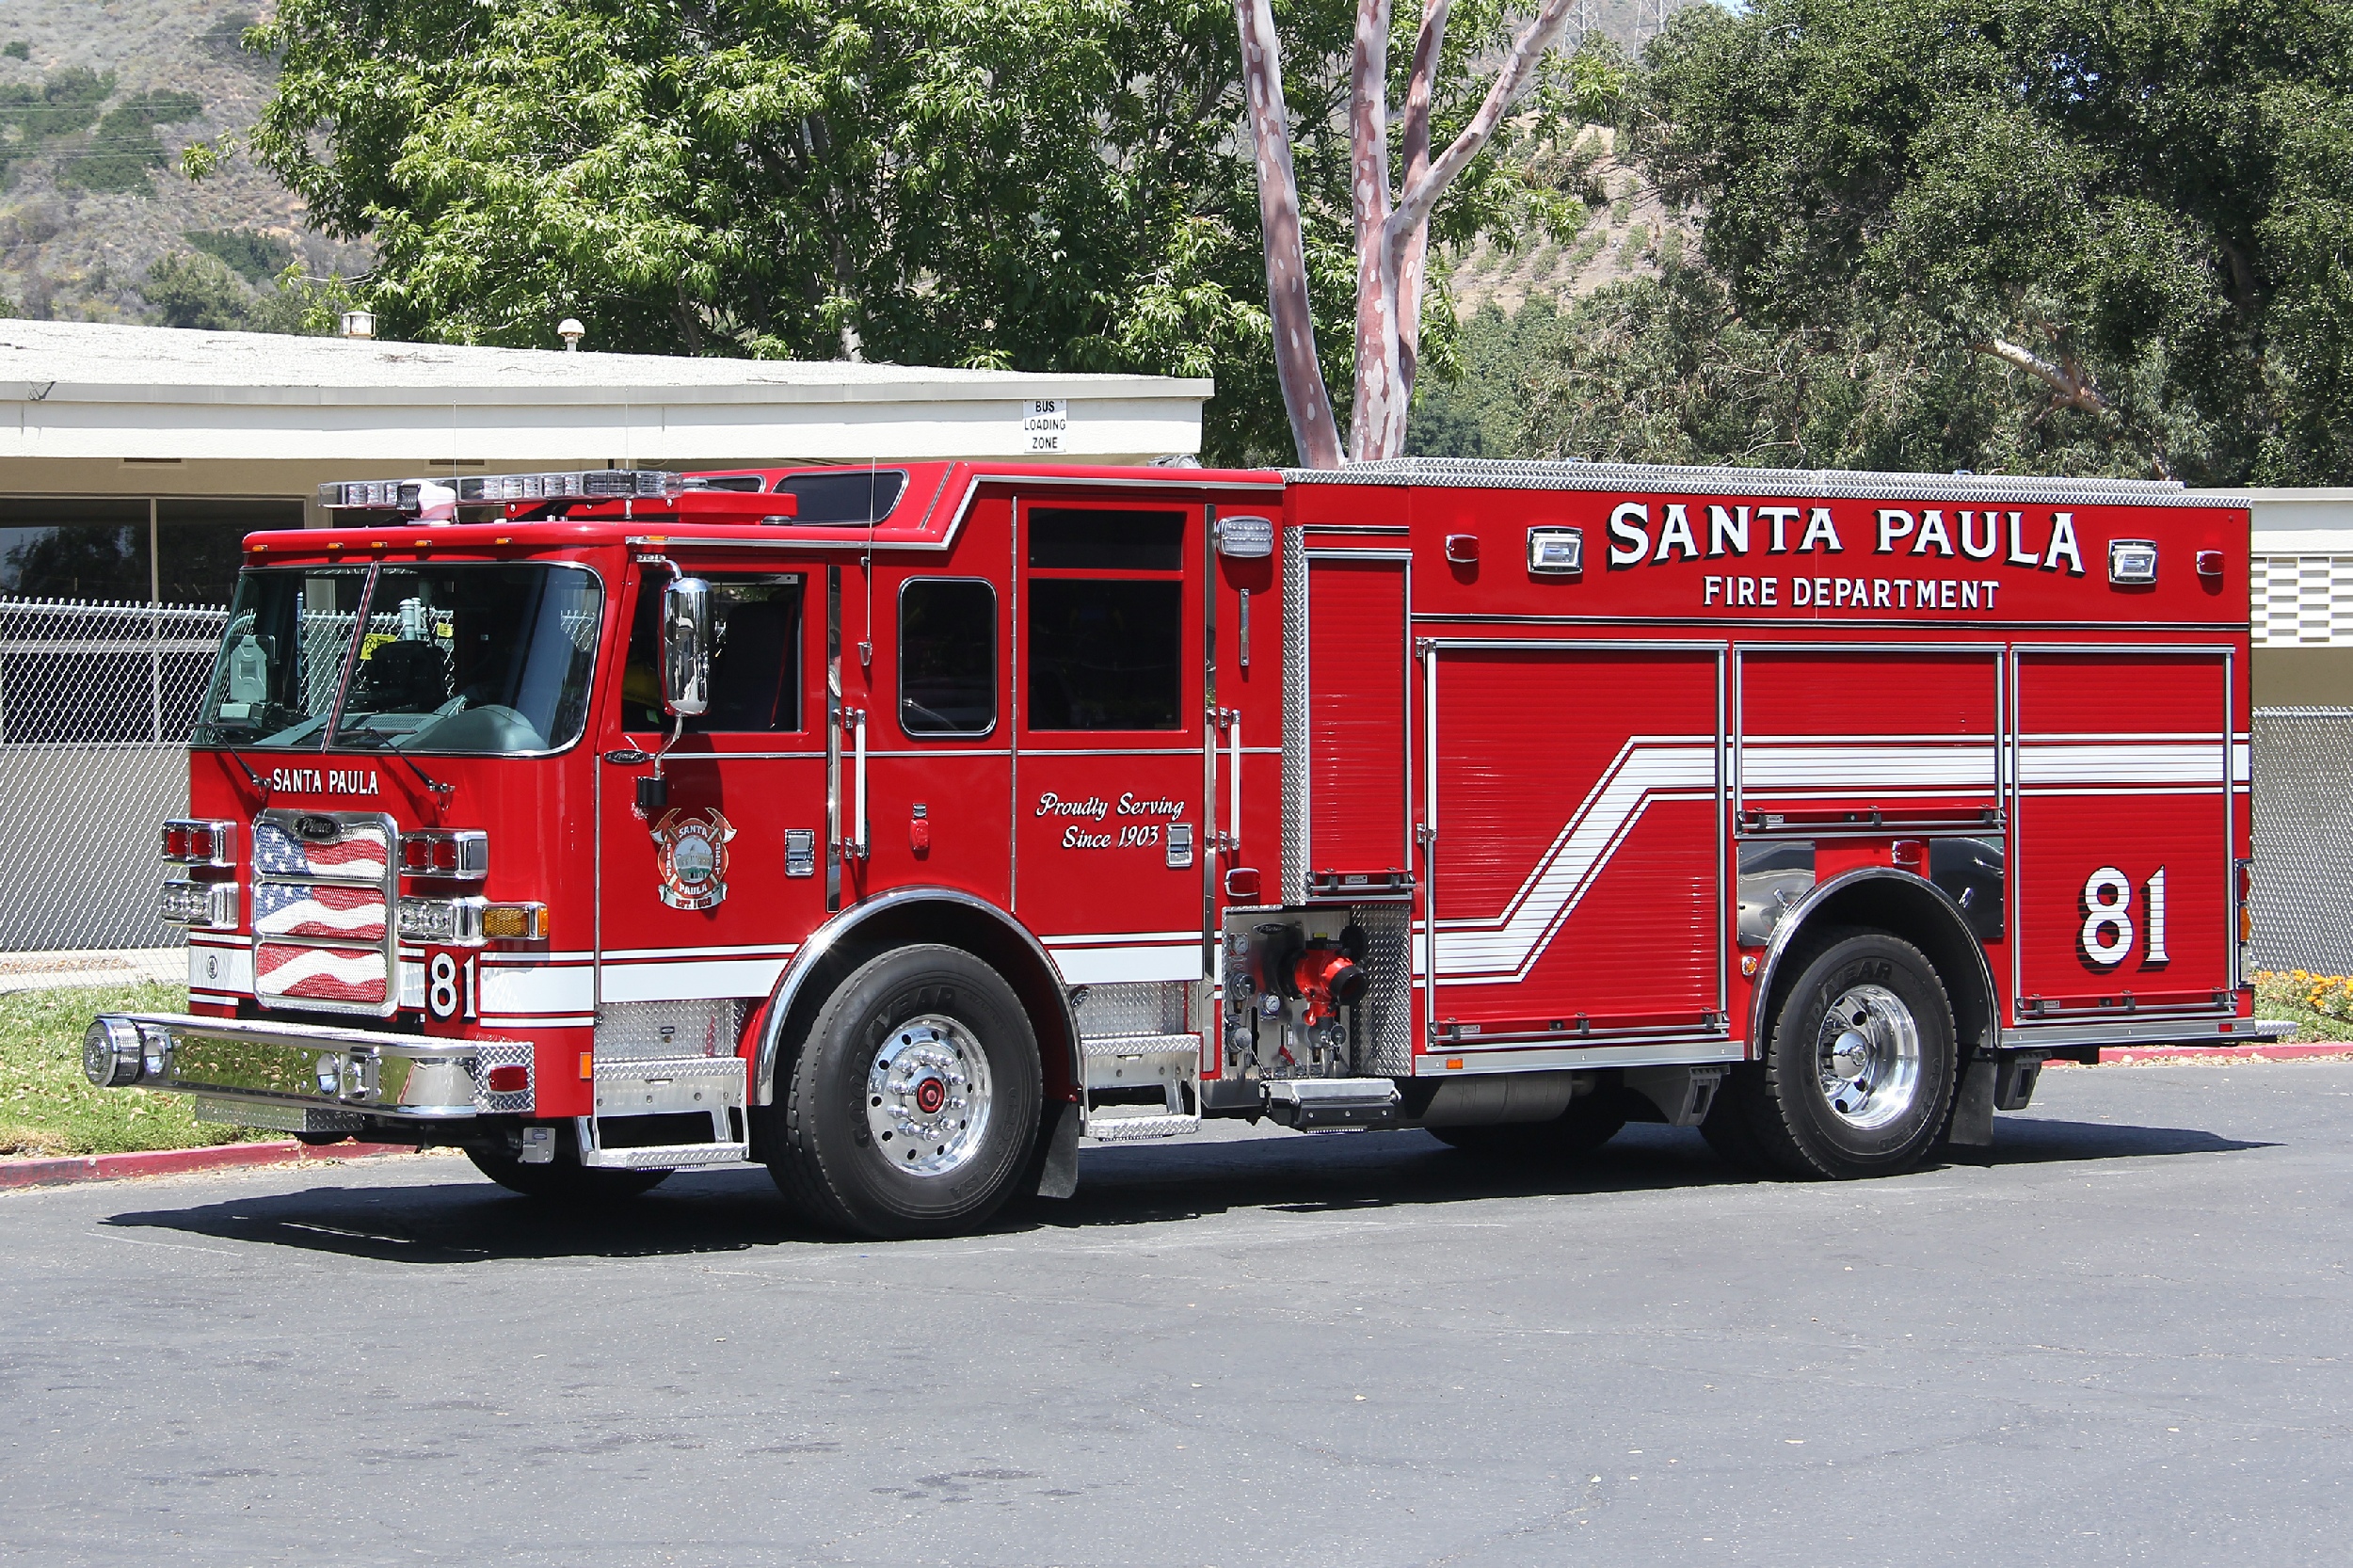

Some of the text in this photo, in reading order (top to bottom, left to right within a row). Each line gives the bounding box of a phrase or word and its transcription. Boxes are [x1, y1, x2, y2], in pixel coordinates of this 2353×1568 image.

[1035, 400, 1055, 412] BUS
[1024, 419, 1066, 431] LOADING
[1032, 437, 1058, 449] ZONE
[1608, 501, 2086, 575] SANTA PAULA
[1703, 575, 2001, 609] FIRE DEPARTMENT
[272, 767, 379, 795] SANTA PAULA
[1036, 792, 1186, 822] Proudly Serving
[678, 824, 709, 839] SANTA
[1062, 824, 1160, 849] Since 1903
[678, 882, 708, 895] PAULA
[2079, 864, 2171, 968] 81
[429, 952, 478, 1020] 81
[849, 985, 957, 1149] GOODYEAR
